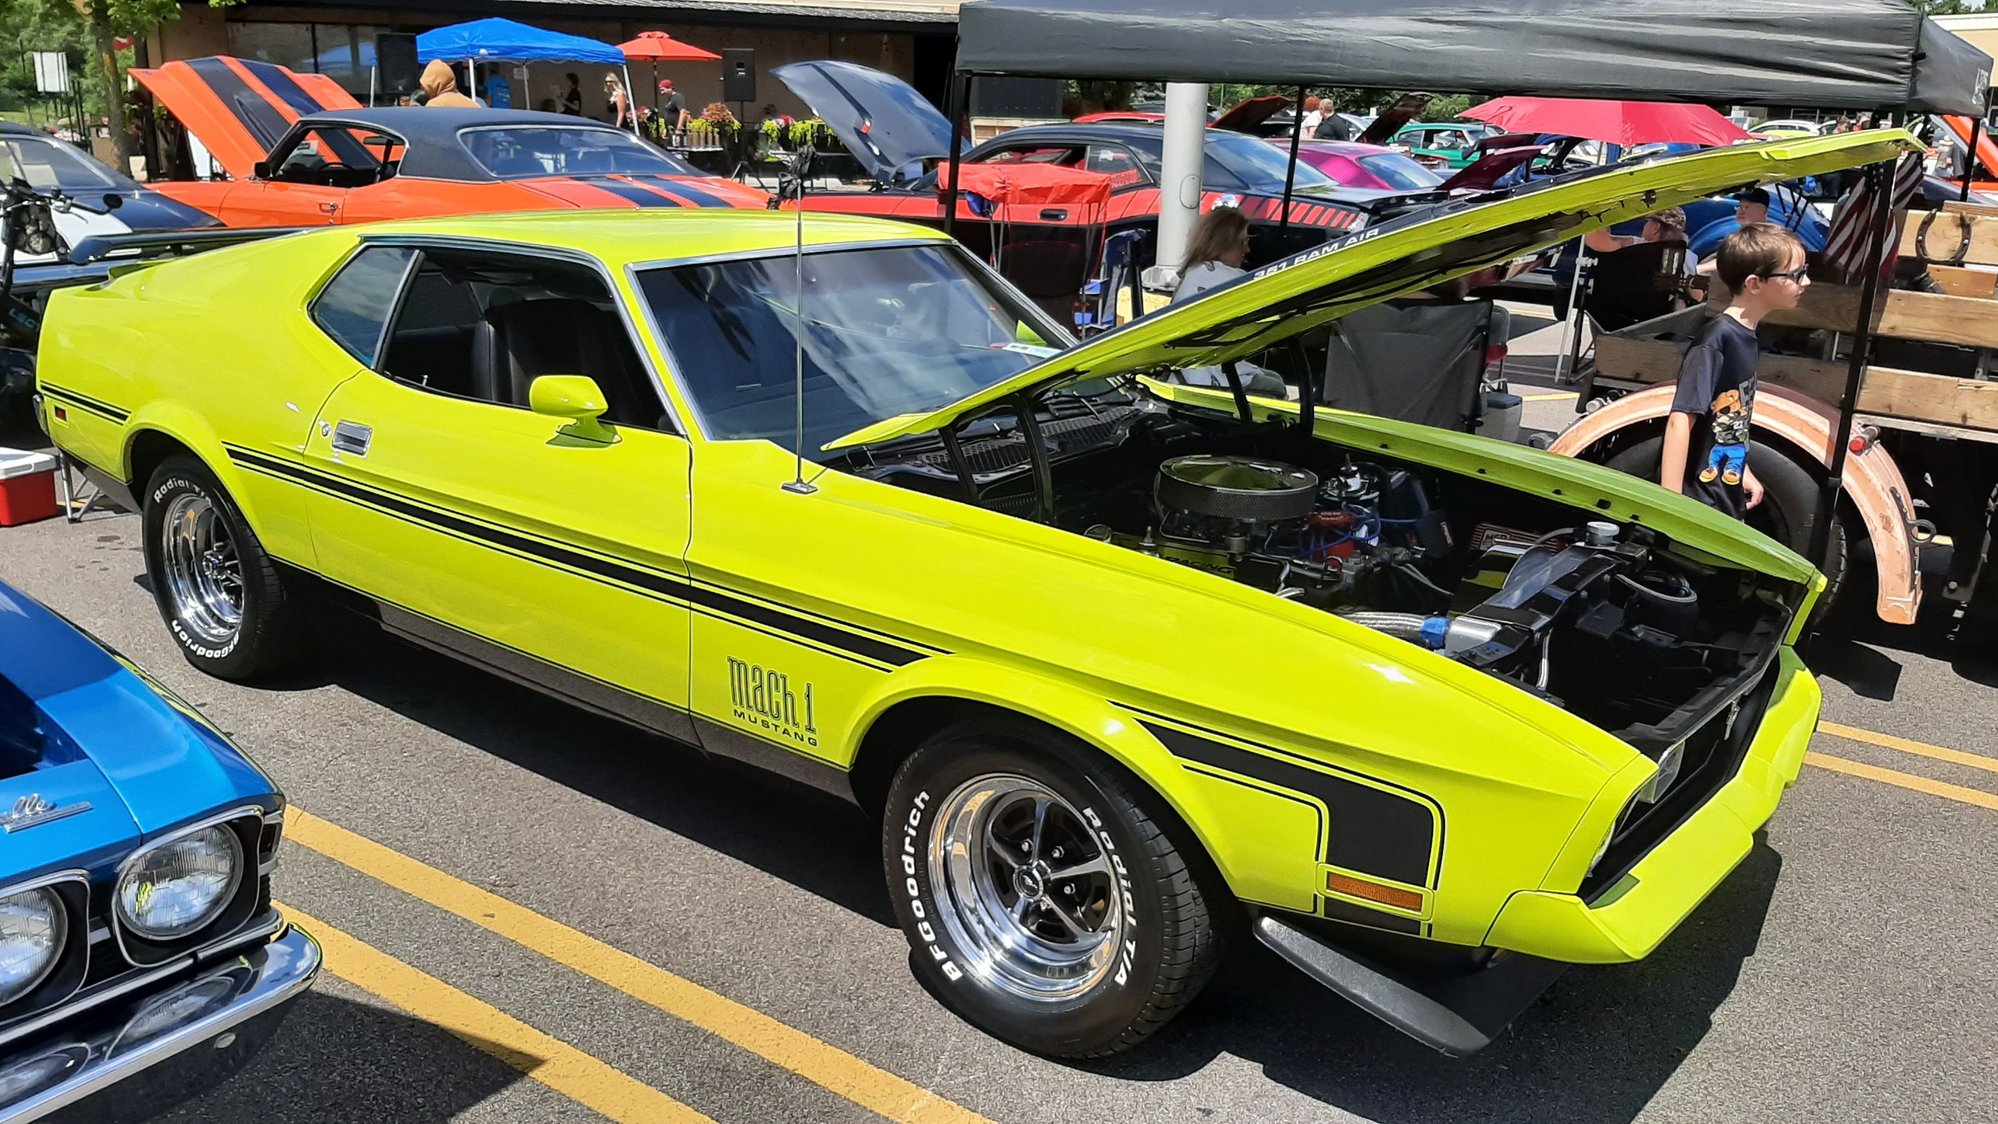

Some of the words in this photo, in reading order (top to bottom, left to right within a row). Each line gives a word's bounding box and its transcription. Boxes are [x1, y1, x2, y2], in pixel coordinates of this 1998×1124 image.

[1293, 241, 1339, 265] RAM
[1344, 228, 1380, 247] AIR
[153, 477, 190, 504] Radial
[171, 619, 240, 659] BFGoodrich
[733, 709, 818, 747] MUSTANG
[804, 682, 817, 734] 1
[902, 790, 964, 981] BFGoodrich
[1082, 807, 1137, 927] Radial
[1114, 939, 1137, 986] T/A
